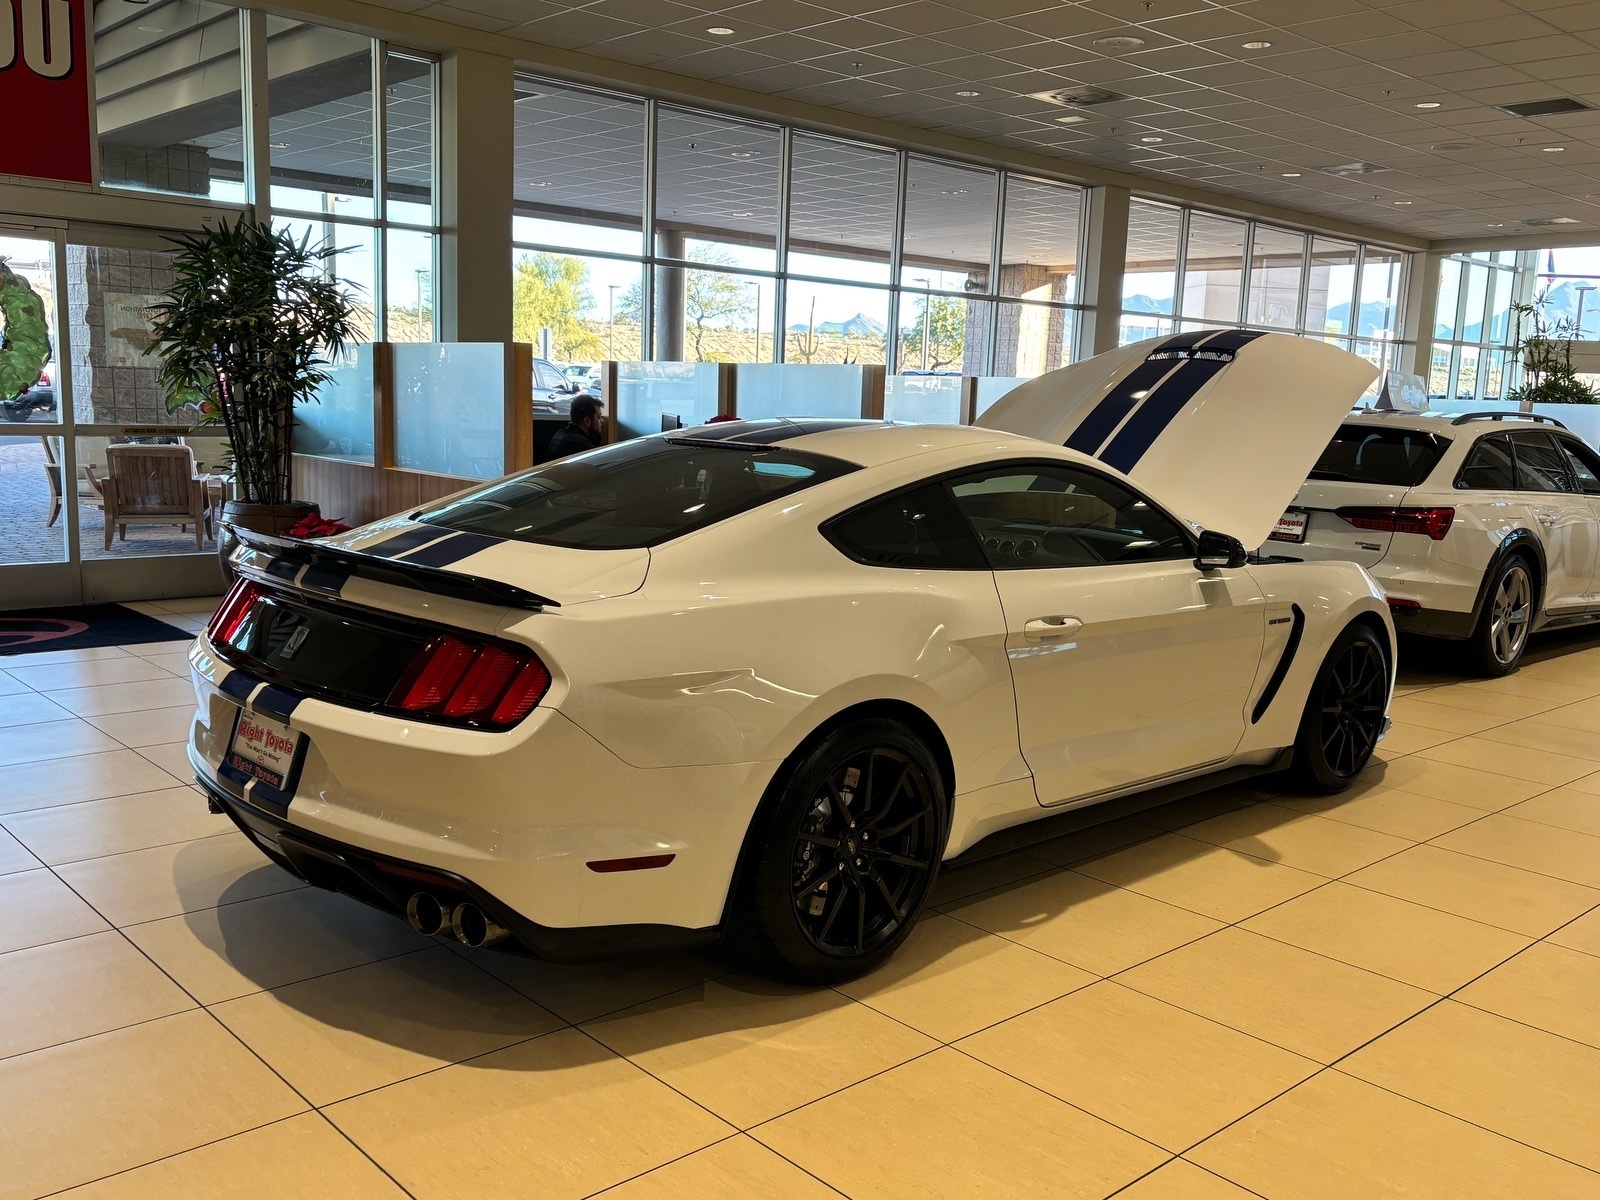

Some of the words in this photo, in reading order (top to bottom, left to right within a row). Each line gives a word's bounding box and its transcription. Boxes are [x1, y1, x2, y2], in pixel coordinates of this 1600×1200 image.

[1279, 518, 1304, 527] Toyota
[239, 718, 265, 743] Right
[264, 729, 294, 756] Toyota
[232, 755, 253, 773] Right
[255, 766, 279, 786] Toyota
